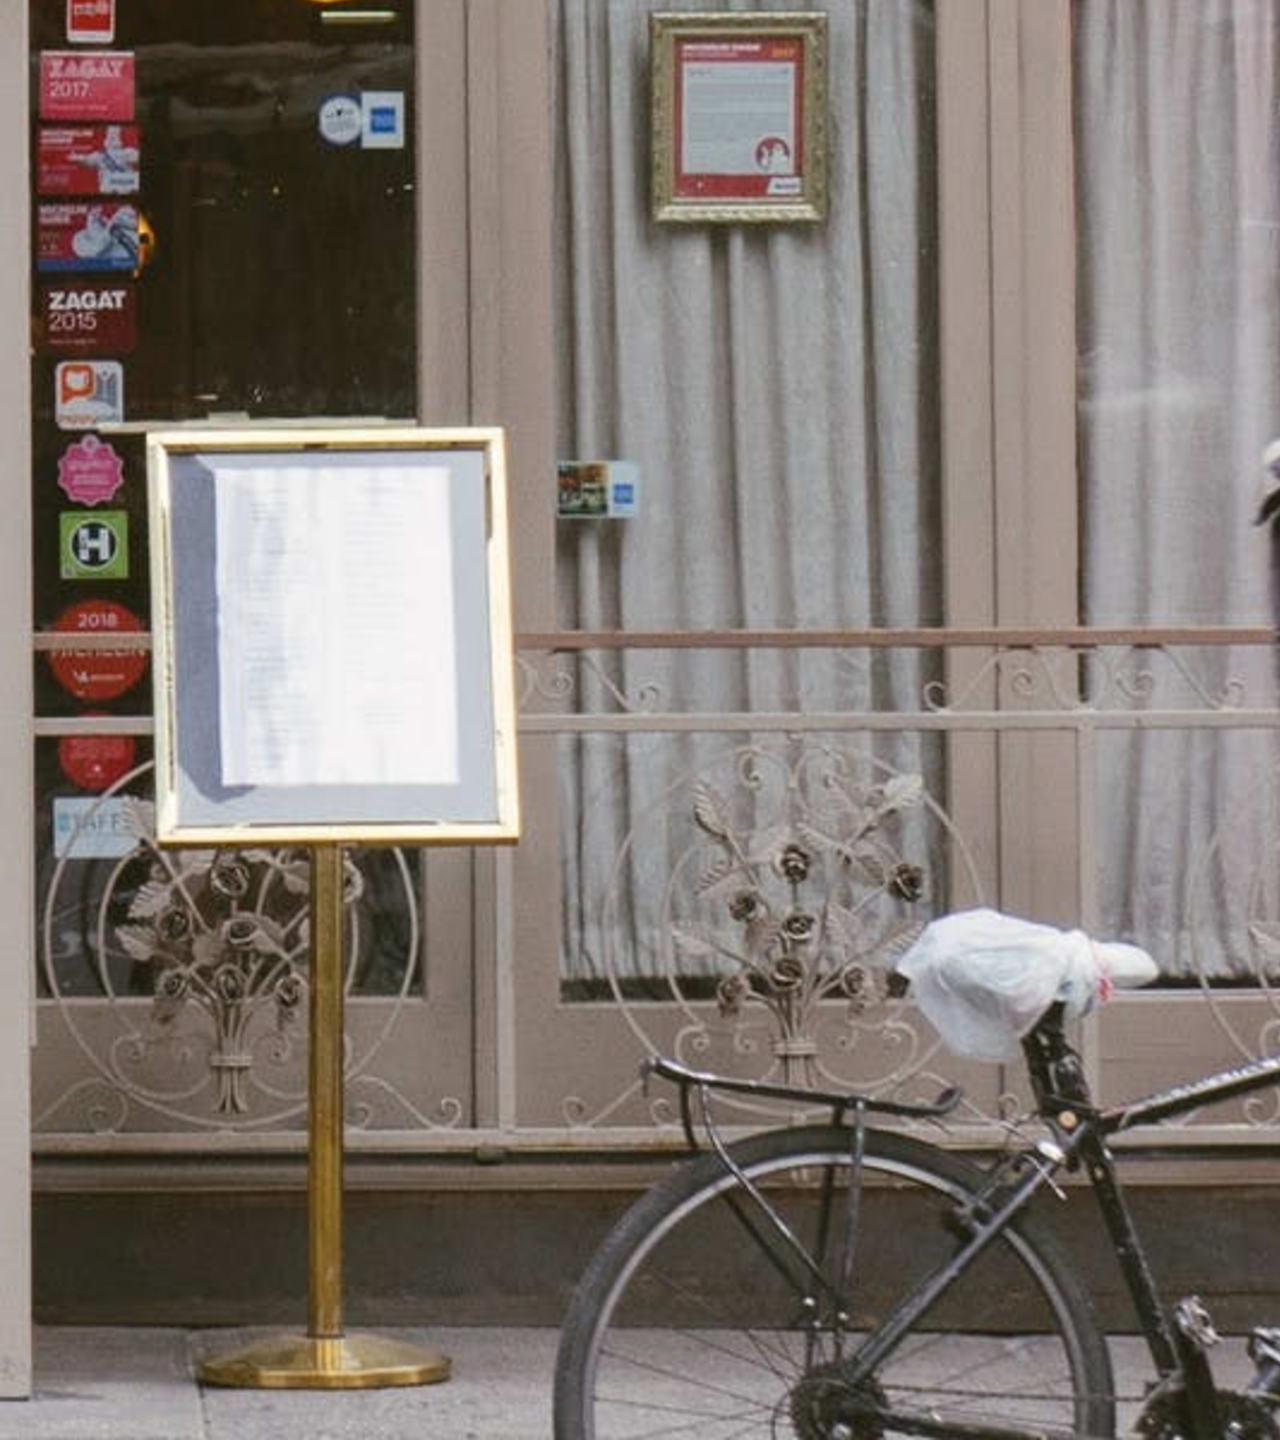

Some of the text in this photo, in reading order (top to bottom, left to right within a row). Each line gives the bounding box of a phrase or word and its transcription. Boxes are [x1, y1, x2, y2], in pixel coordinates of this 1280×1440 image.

[48, 58, 125, 78] ZAGAT
[48, 80, 91, 97] 2017
[48, 290, 127, 310] ZAGAT
[48, 311, 97, 331] 2015
[77, 612, 119, 628] 2018
